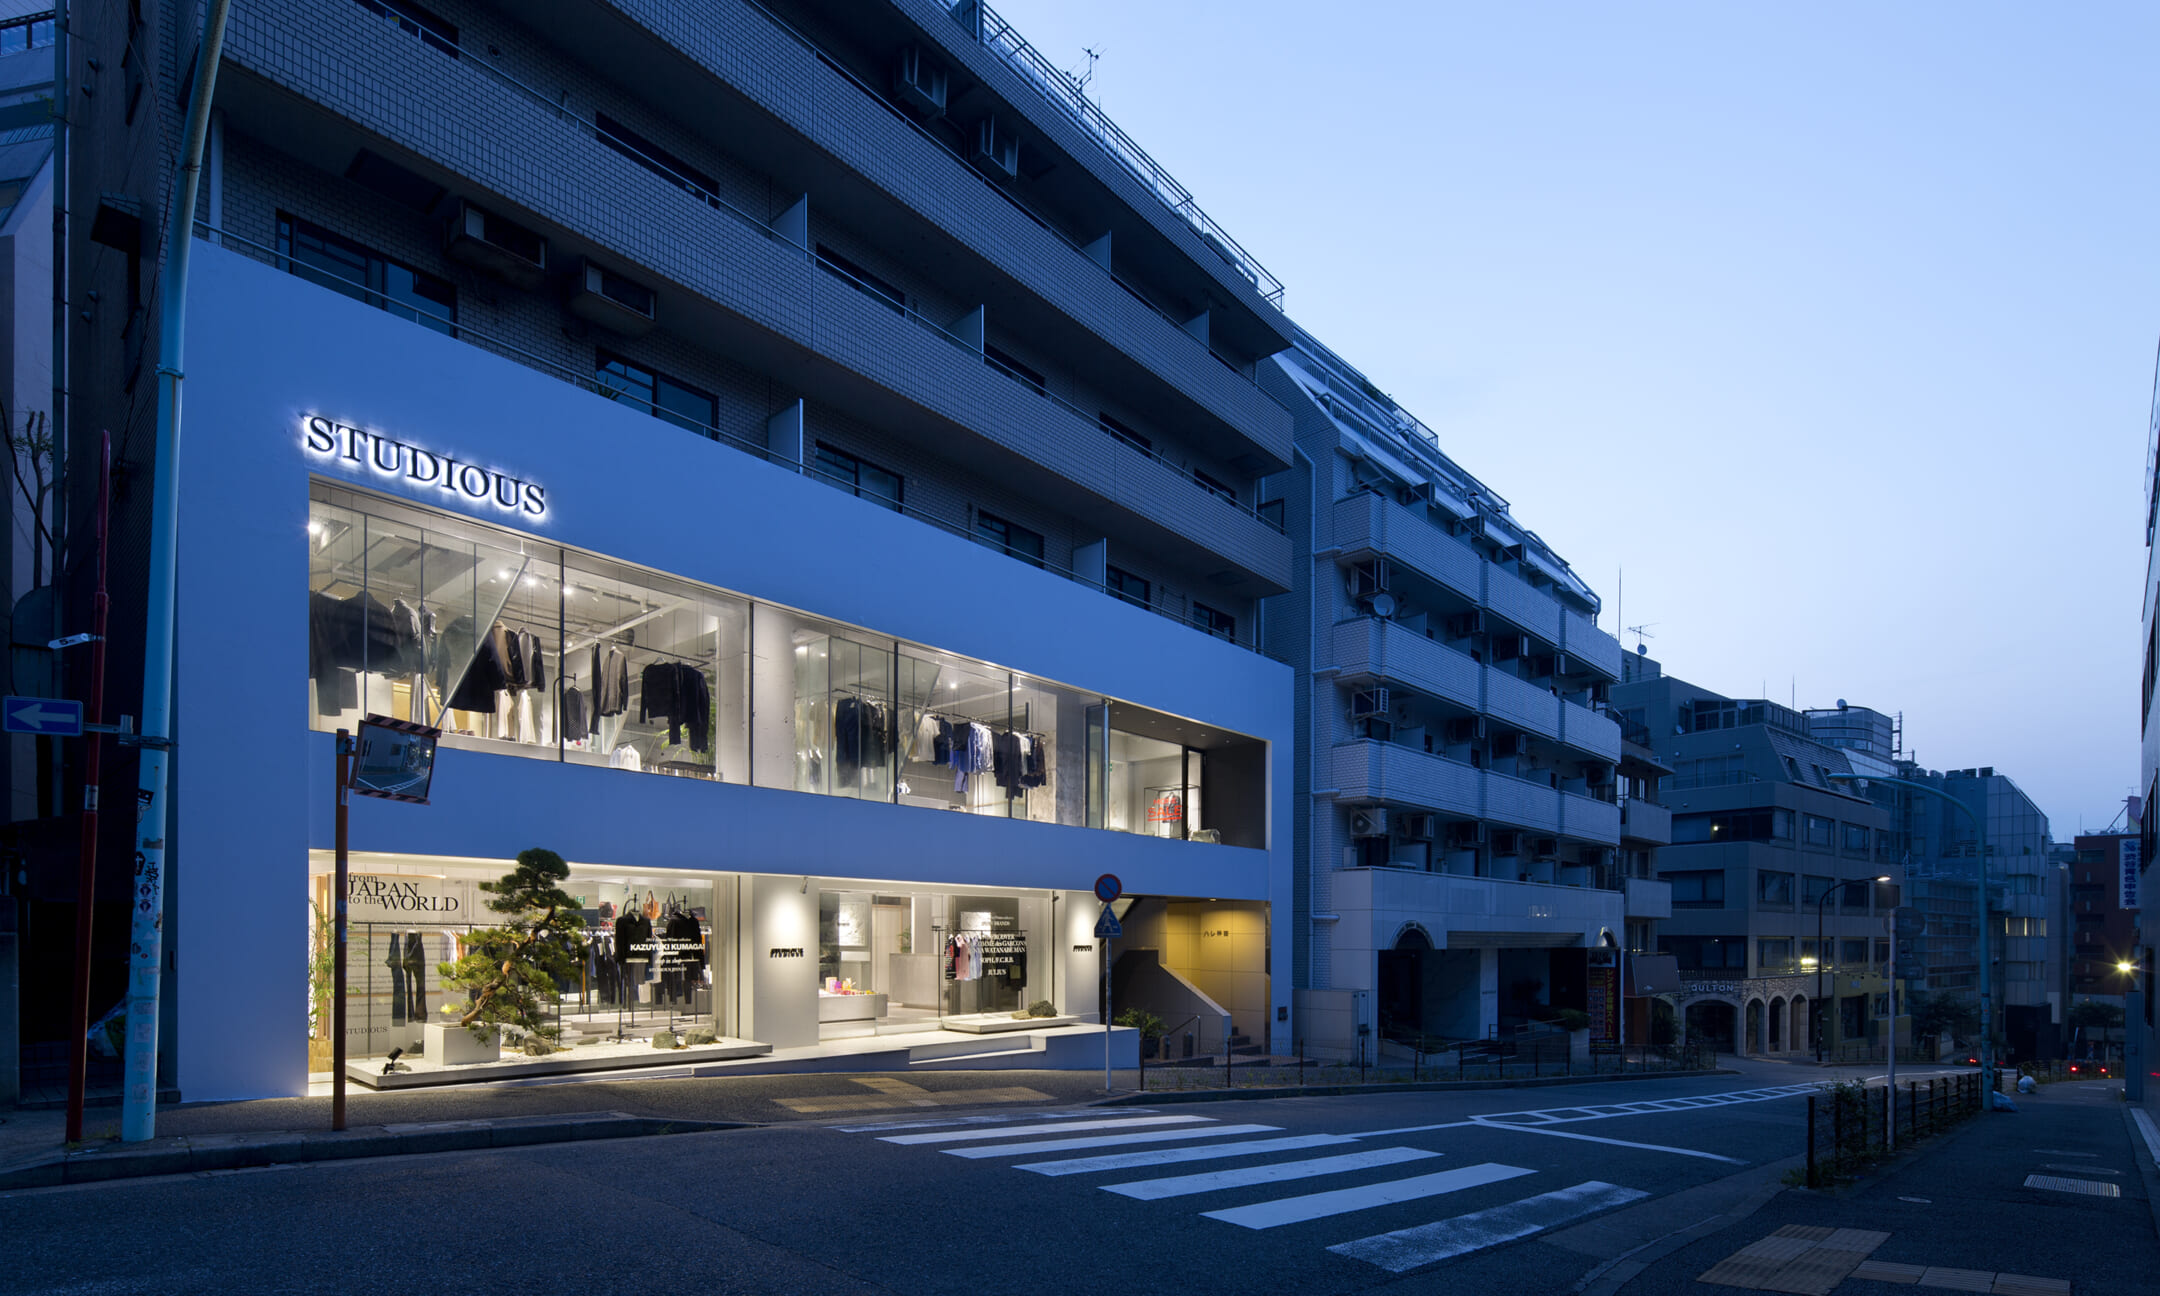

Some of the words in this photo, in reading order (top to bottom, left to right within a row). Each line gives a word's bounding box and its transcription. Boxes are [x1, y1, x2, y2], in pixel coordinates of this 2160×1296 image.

[307, 416, 545, 515] STUDIOUS
[1147, 805, 1183, 818] SALE
[349, 872, 378, 883] from
[348, 881, 420, 897] JAPAN
[348, 895, 361, 905] to
[364, 895, 383, 905] the
[381, 896, 459, 911] WORLD
